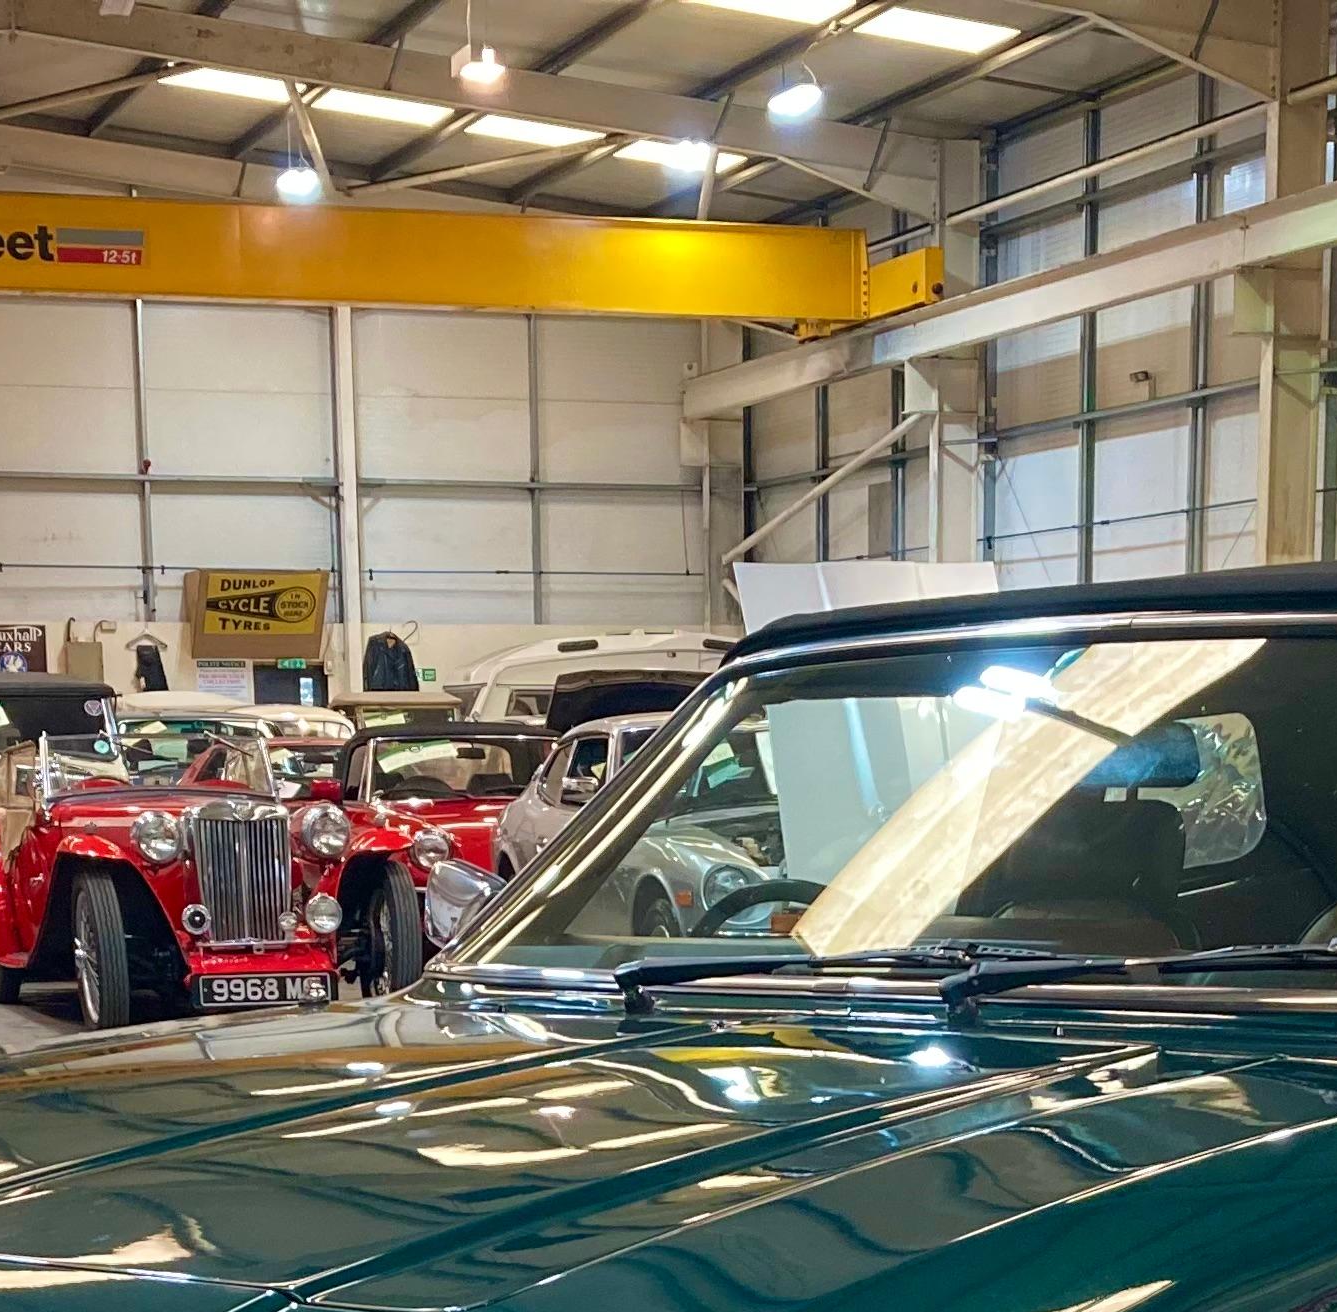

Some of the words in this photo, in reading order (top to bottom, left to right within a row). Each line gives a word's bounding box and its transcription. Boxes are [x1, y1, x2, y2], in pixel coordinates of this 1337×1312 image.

[220, 579, 276, 591] DUNLOP
[218, 597, 271, 613] CYCLE
[218, 617, 270, 630] TYRES
[212, 977, 280, 1001] 9968
